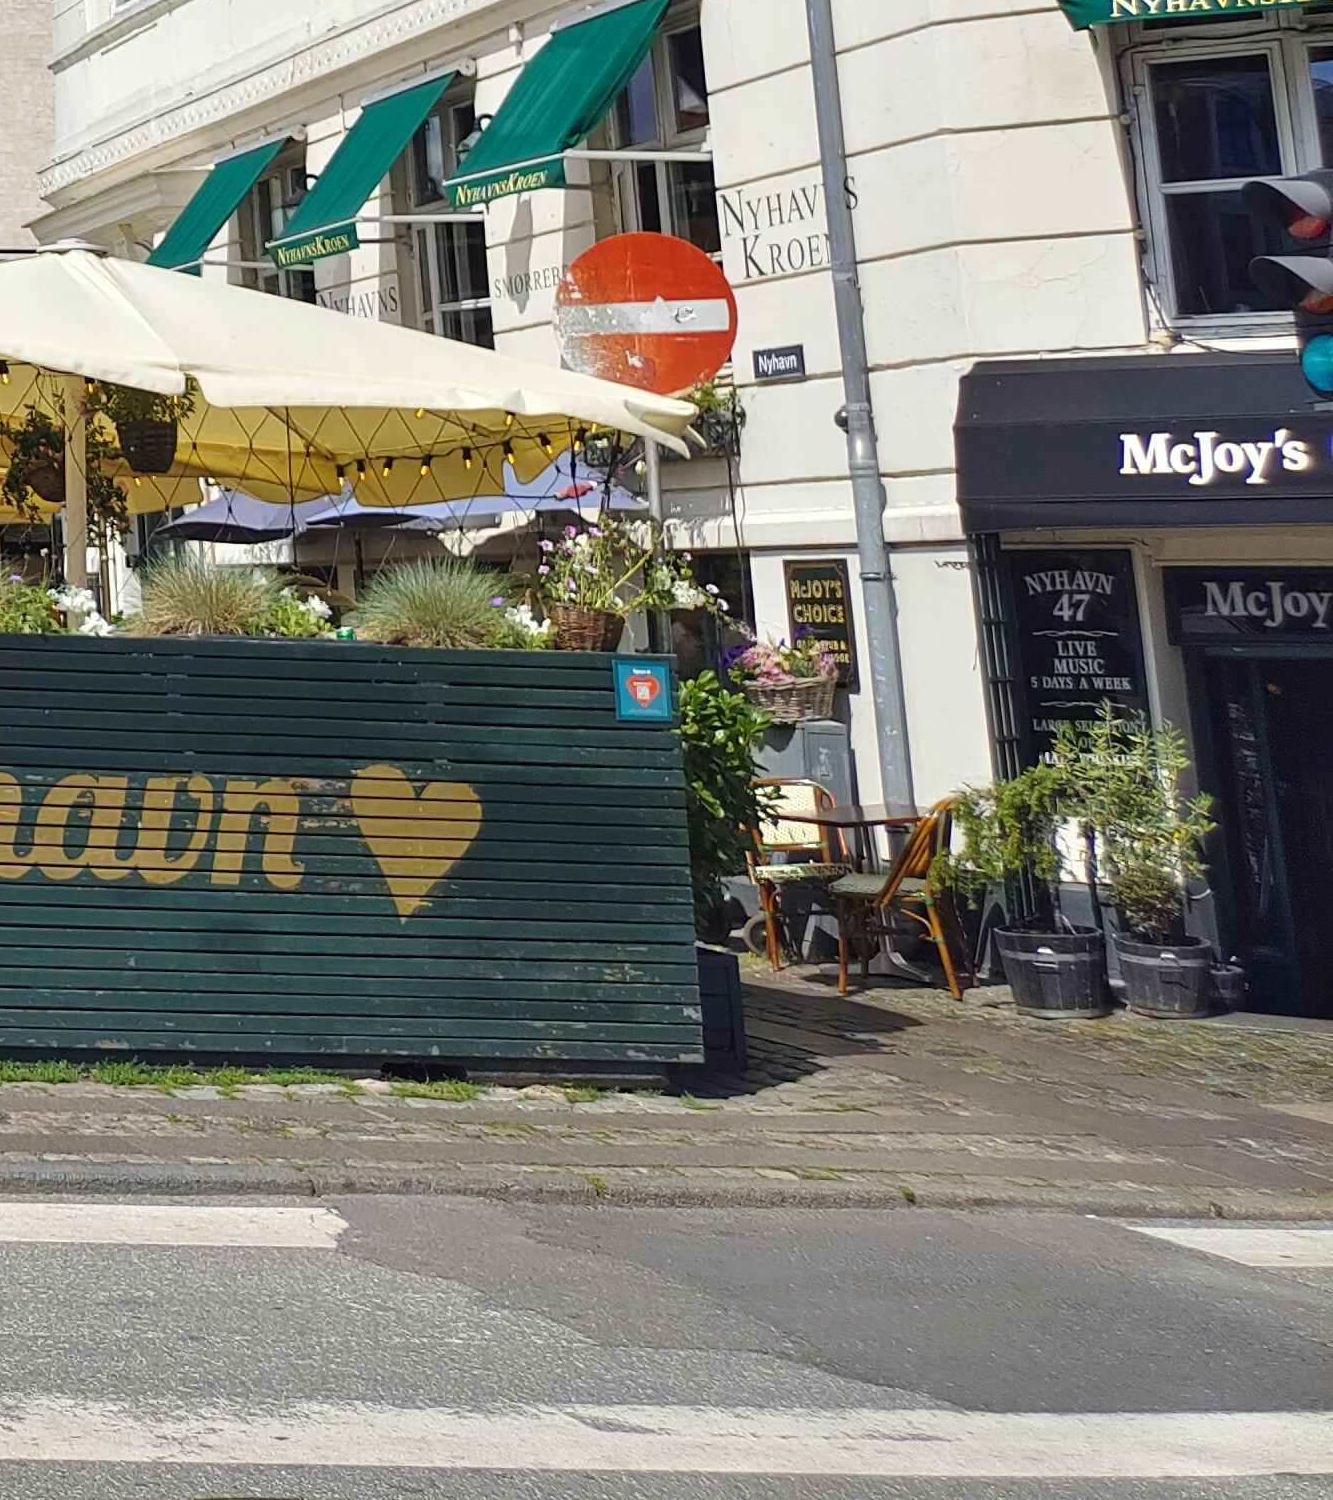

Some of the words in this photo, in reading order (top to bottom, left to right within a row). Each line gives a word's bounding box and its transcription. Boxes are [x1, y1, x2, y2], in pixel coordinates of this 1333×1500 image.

[720, 176, 858, 237] NYHAVS
[758, 353, 798, 376] Nyhavn
[1119, 428, 1312, 485] McJoy's
[1025, 570, 1115, 596] NYHAVN
[794, 604, 845, 622] CHOICE
[1052, 593, 1091, 622] 47
[1202, 581, 1333, 628] McJoy
[1057, 640, 1097, 657] LIVE
[1054, 658, 1105, 675] MUSIC
[1031, 676, 1038, 688] 5
[1043, 676, 1073, 689] DAYS
[1080, 677, 1090, 690] A
[1092, 677, 1132, 690] WEEK
